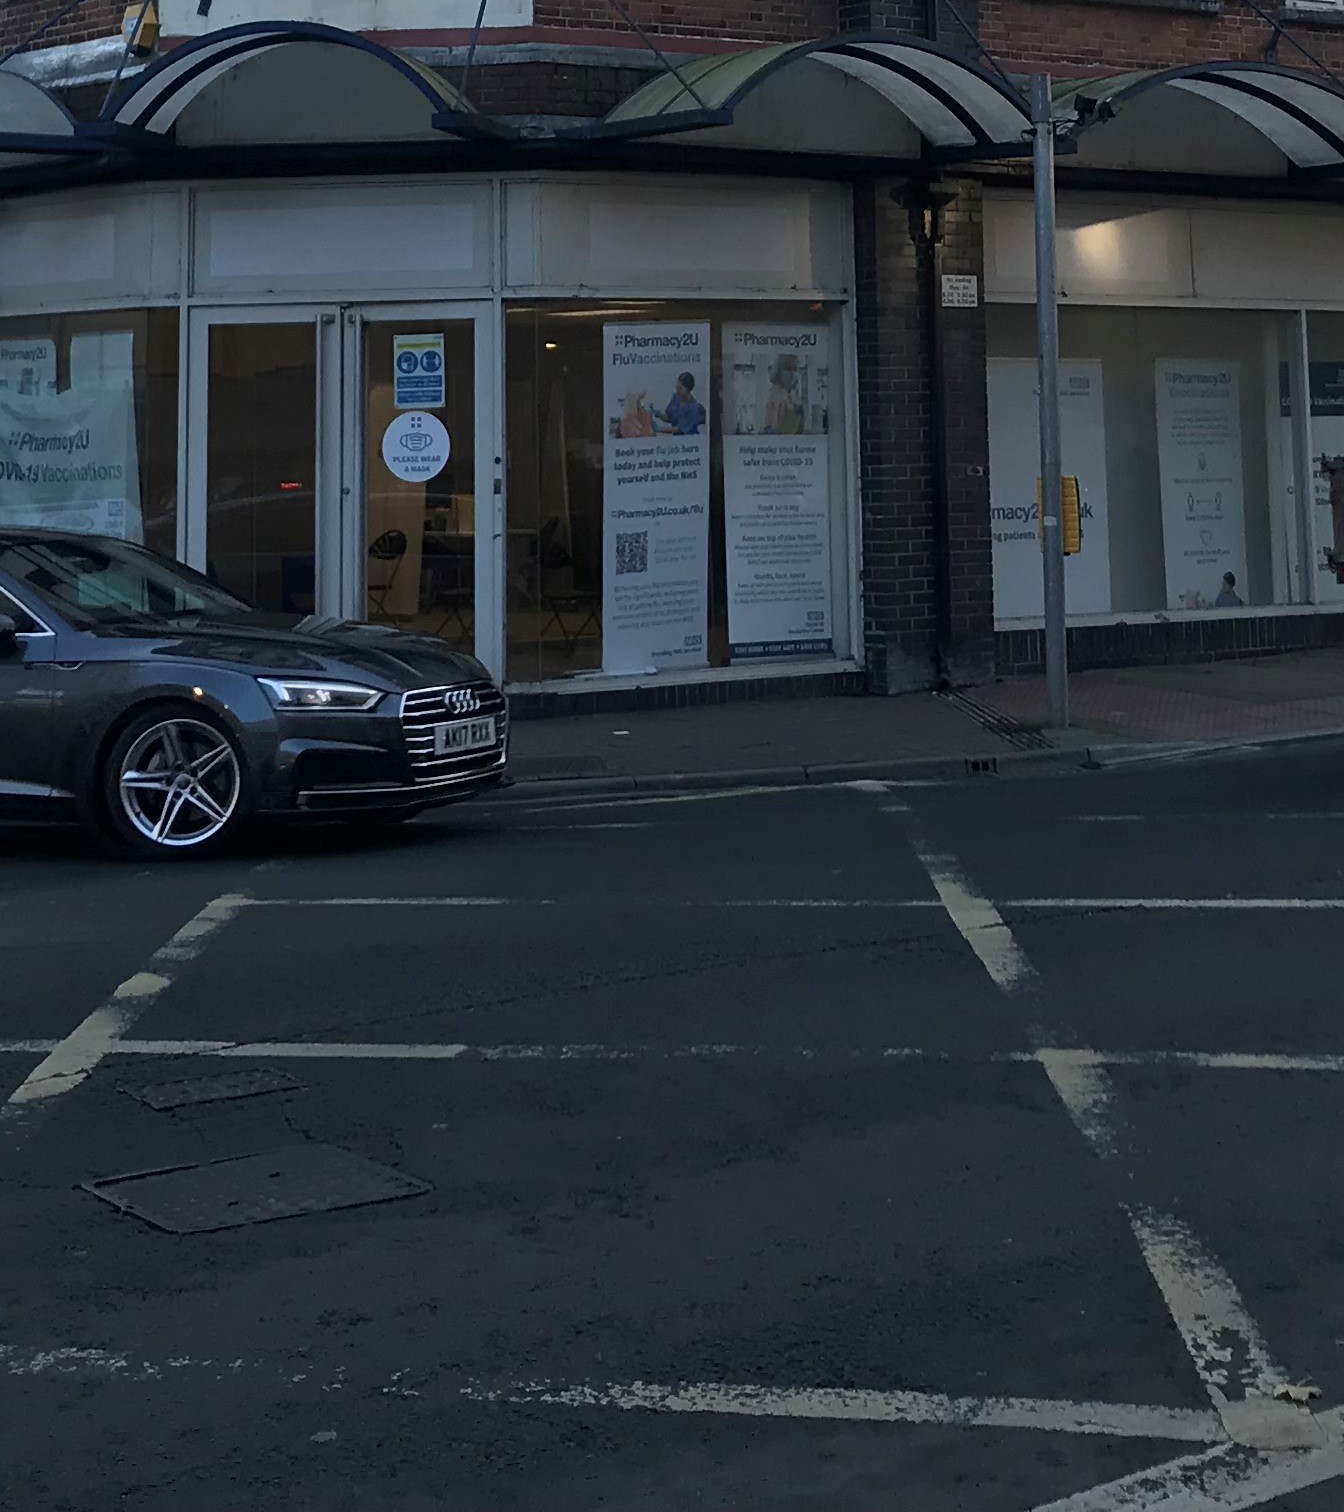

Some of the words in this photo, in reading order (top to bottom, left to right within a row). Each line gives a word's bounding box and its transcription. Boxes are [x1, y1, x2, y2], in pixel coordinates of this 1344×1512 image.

[624, 332, 699, 349] Pharmacy2U
[744, 332, 817, 349] Pharmacy2U
[1172, 372, 1232, 386] Pharmacy2U
[18, 429, 91, 455] Pharmacy2U
[615, 448, 635, 458] Book
[637, 448, 654, 458] your
[681, 444, 699, 454] here
[392, 455, 419, 463] PLEASE
[420, 455, 441, 463] WEAR
[614, 461, 636, 472] today
[638, 460, 652, 469] and
[654, 459, 671, 469] help
[672, 457, 701, 468] protect
[616, 473, 650, 486] yourself
[650, 472, 665, 482] and
[666, 471, 680, 481] the
[681, 470, 698, 480] NHS
